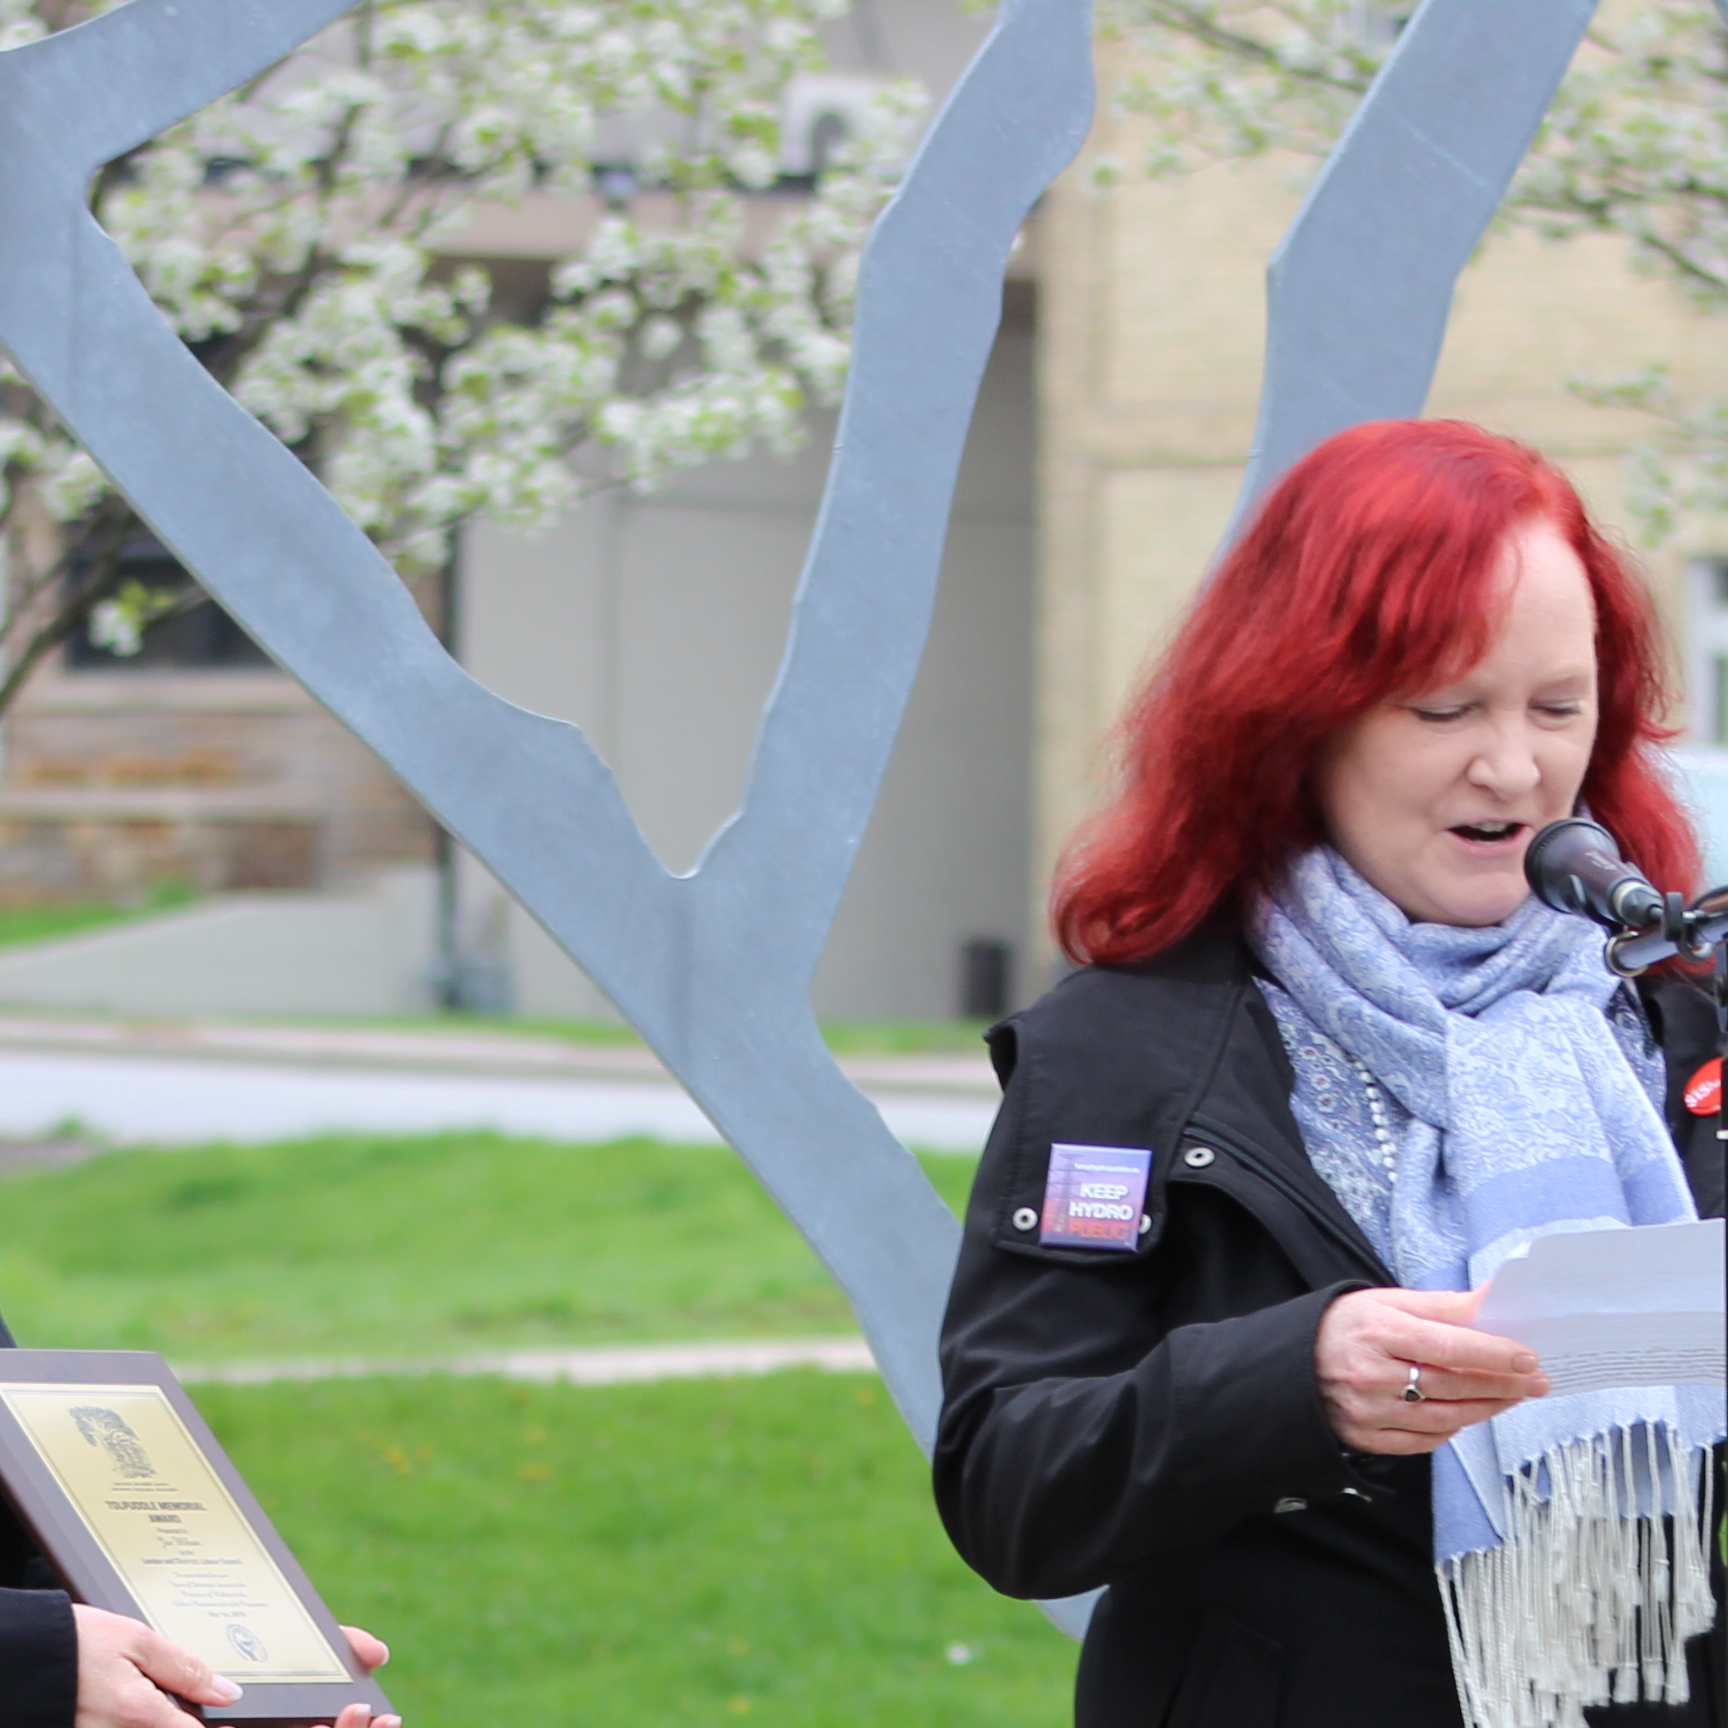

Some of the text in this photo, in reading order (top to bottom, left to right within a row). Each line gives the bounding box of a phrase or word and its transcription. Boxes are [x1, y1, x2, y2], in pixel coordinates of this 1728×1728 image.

[1080, 1183, 1129, 1200] KEEP
[1069, 1201, 1134, 1220] HYDRO
[1068, 1221, 1130, 1239] PUBLIC
